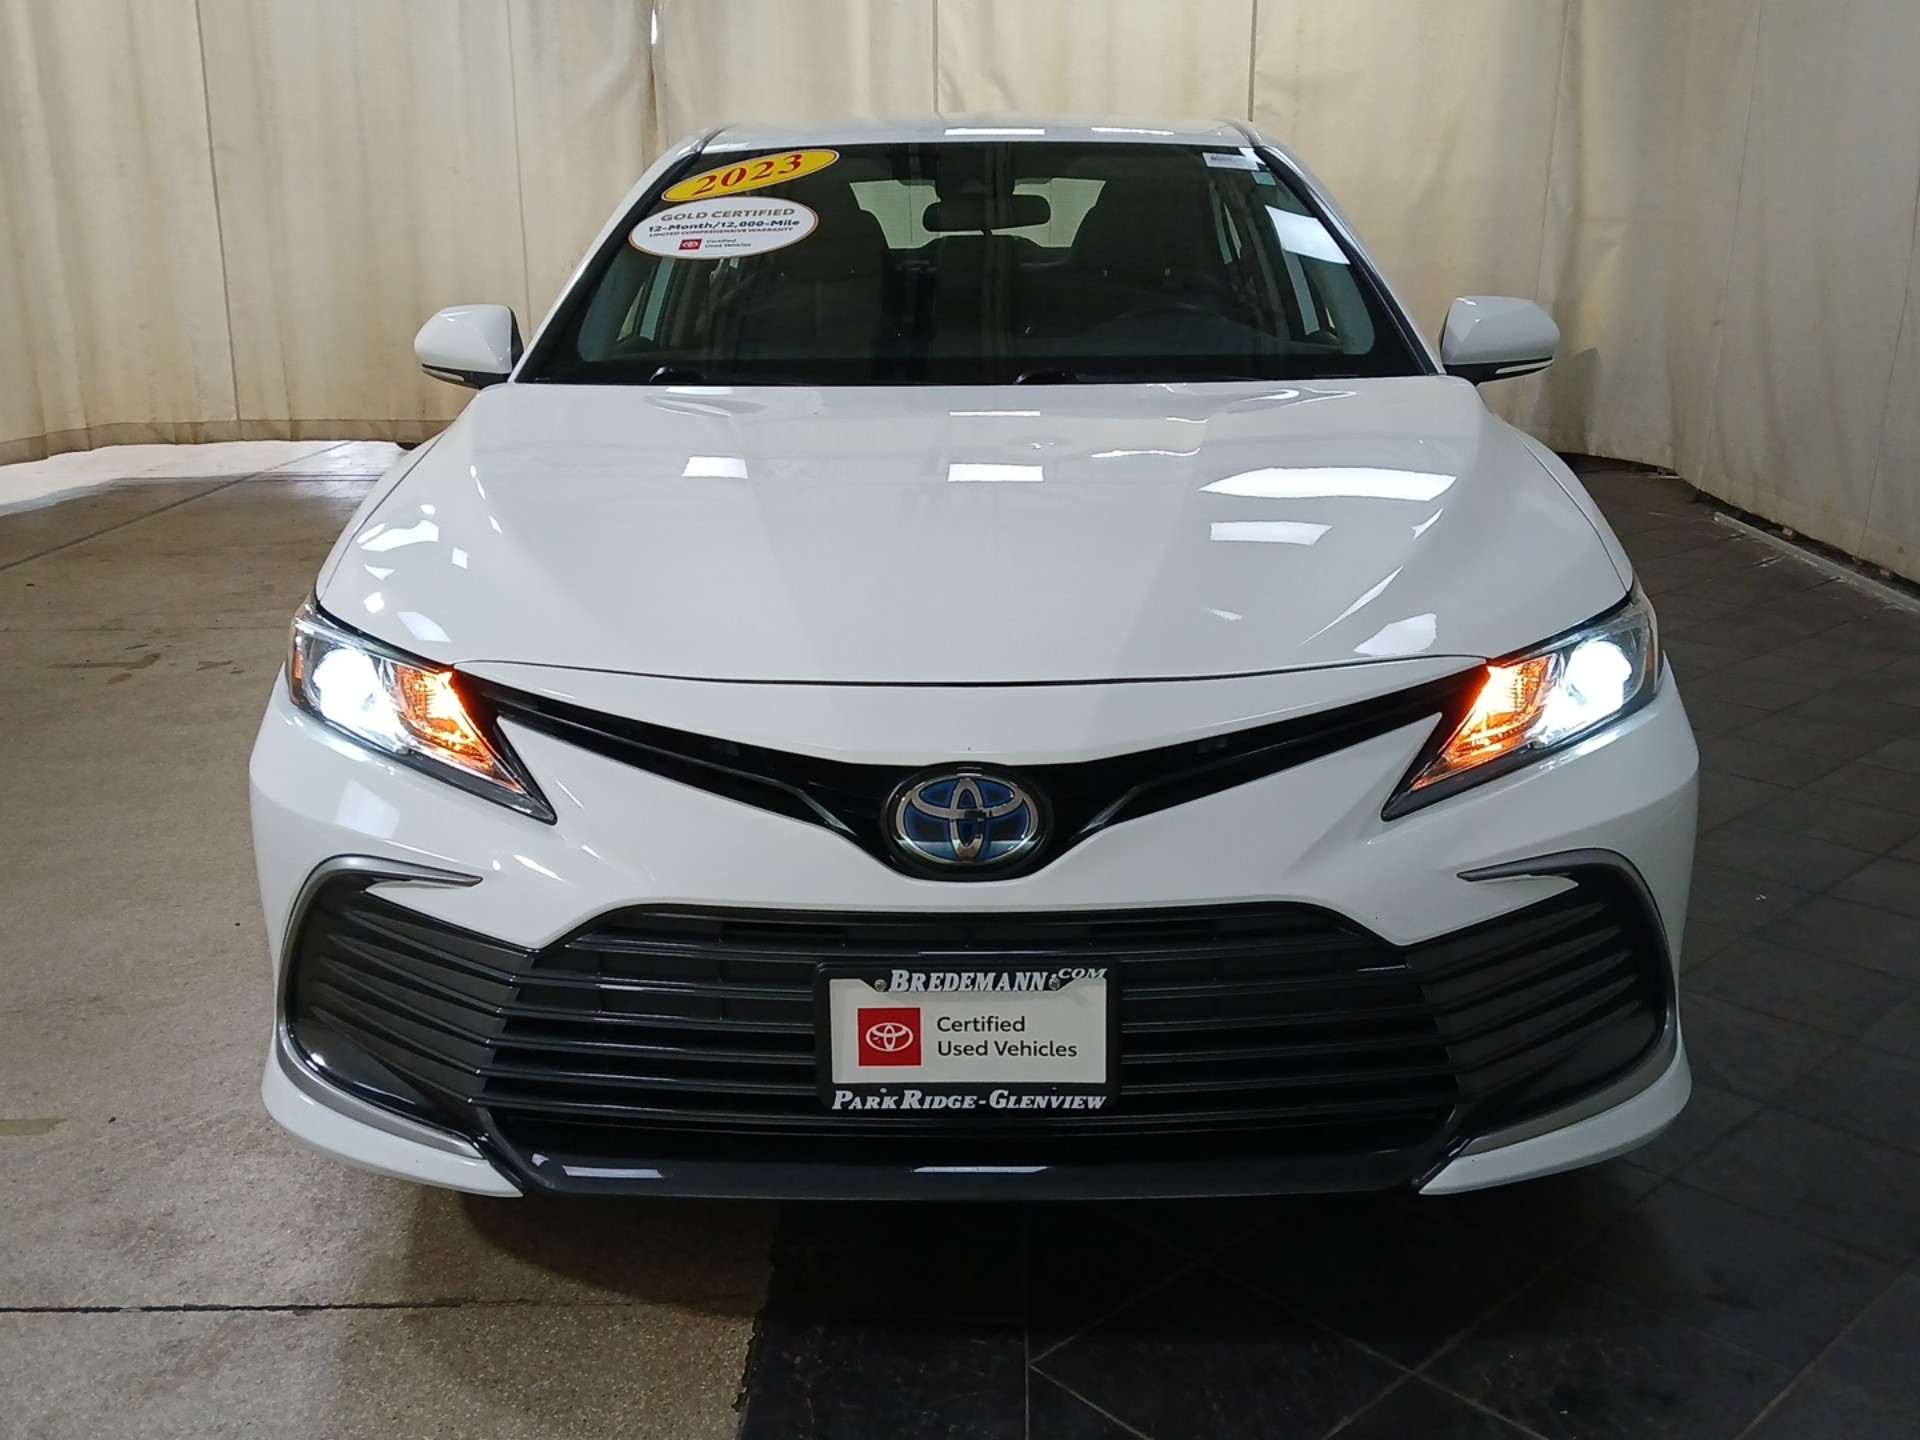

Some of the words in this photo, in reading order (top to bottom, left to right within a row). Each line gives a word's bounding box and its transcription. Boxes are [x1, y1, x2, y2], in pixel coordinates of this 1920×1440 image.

[691, 154, 802, 196] 2023
[661, 211, 708, 222] GOLD
[711, 208, 796, 219] CERTIFIED
[936, 1015, 1026, 1033] Certified
[937, 1040, 989, 1057] Used
[994, 1039, 1078, 1058] Vehicles
